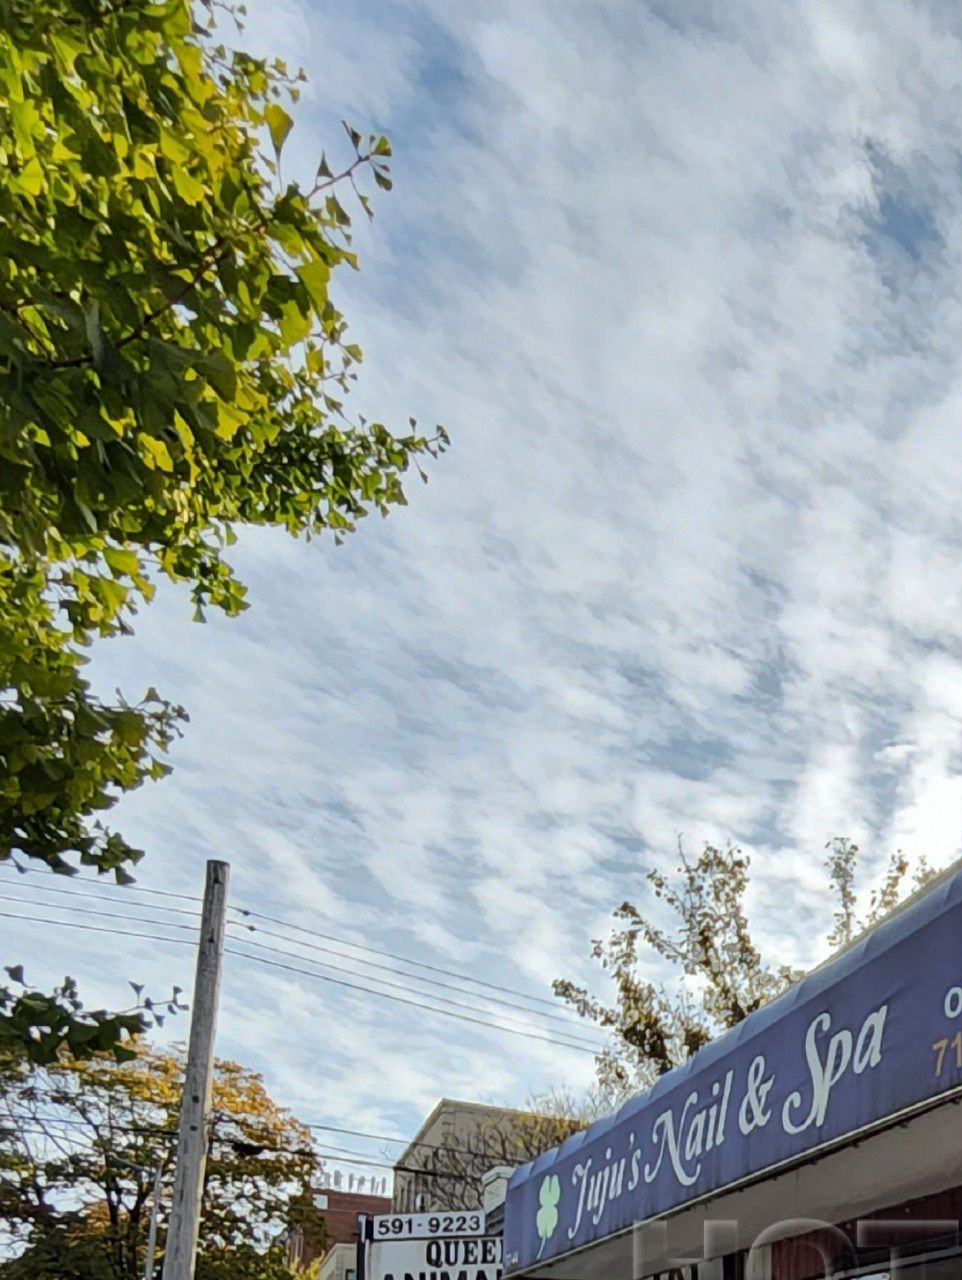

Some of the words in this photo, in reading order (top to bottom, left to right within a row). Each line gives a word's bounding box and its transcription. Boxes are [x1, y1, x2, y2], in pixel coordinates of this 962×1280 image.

[567, 1133, 642, 1240] Juju's
[645, 1069, 734, 1187] Nail
[738, 1055, 777, 1136] &
[782, 1005, 889, 1136] Spa
[426, 1239, 503, 1268] QUEE
